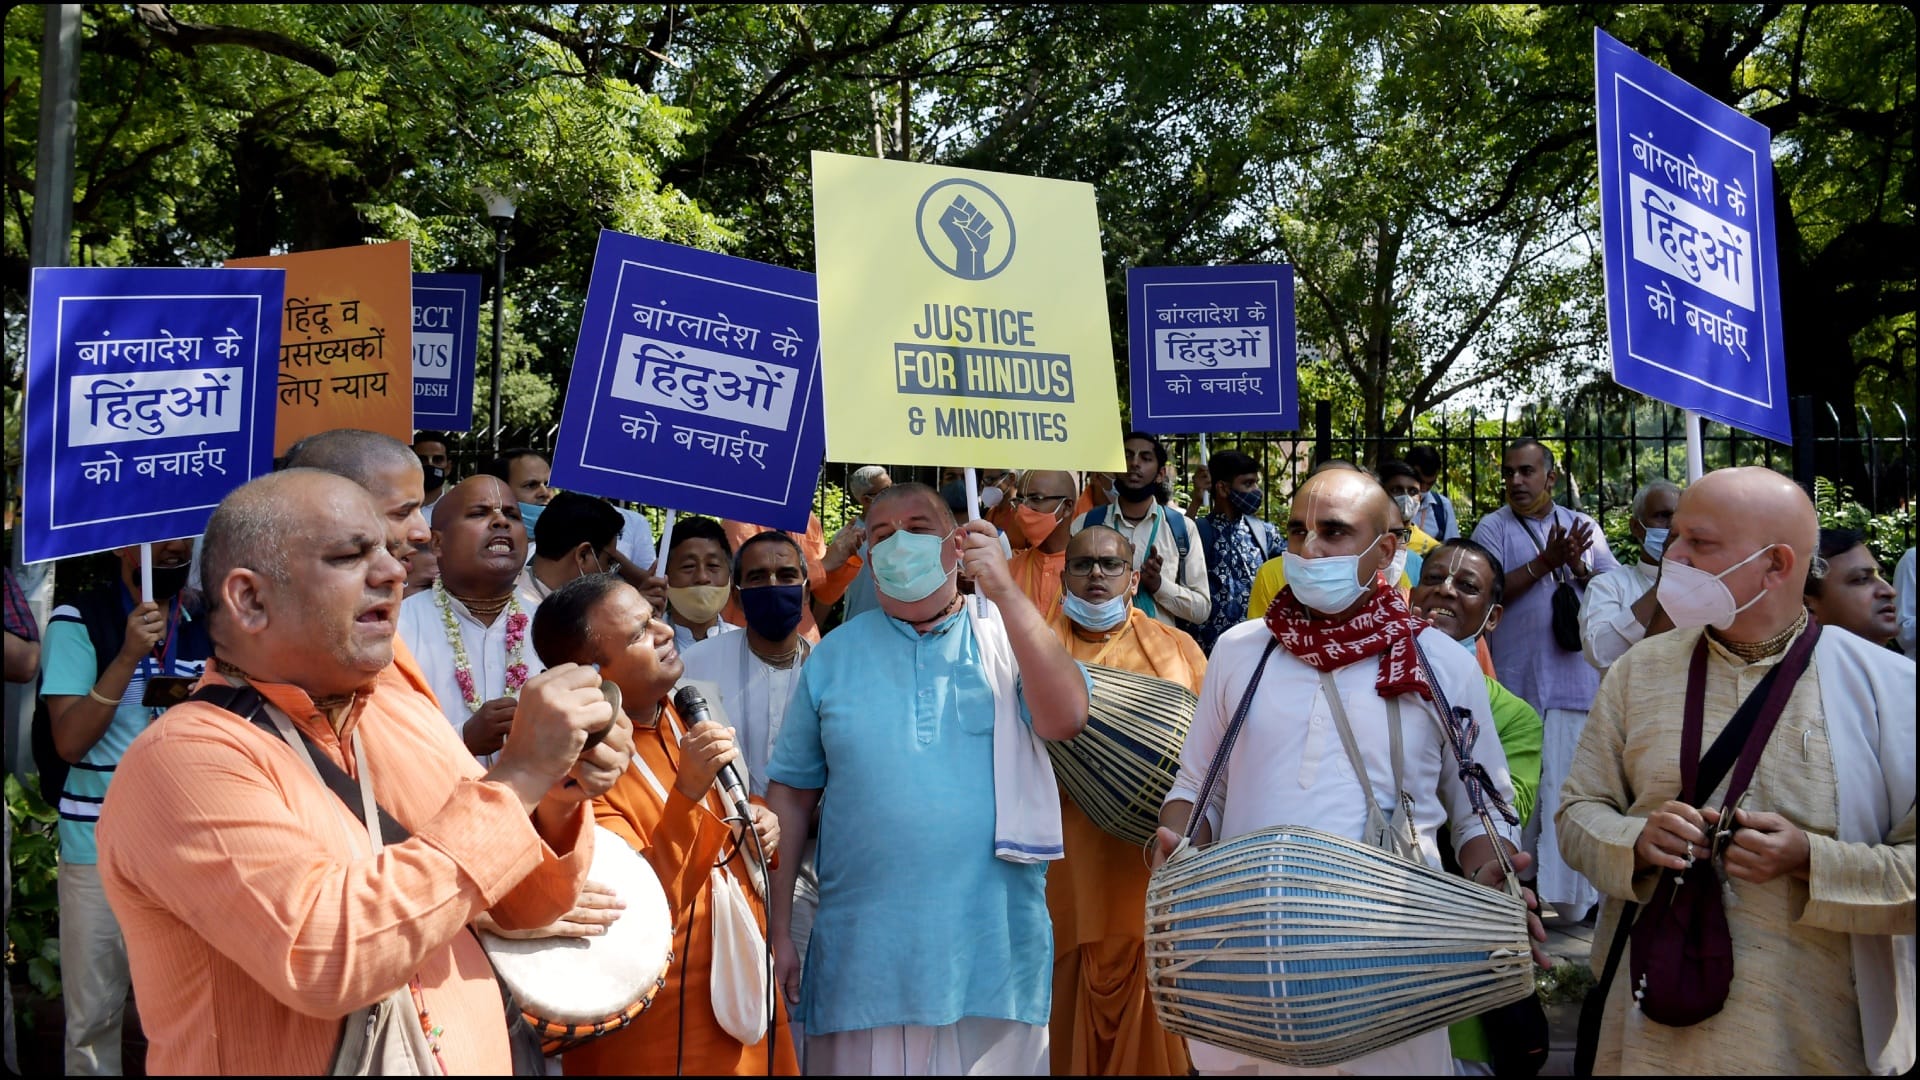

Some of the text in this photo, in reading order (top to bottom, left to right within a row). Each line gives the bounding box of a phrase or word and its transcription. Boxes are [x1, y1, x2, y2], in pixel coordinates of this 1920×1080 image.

[1630, 131, 1748, 217] बांग्लादेश के
[1641, 189, 1743, 284] हिंदुओं
[285, 298, 361, 334] हिंदू व
[632, 300, 804, 358] बांग्लादेश के
[914, 304, 1035, 347] JUSTICE
[1156, 301, 1267, 324] बांग्लादेश के
[1645, 280, 1750, 362] को बचाईए
[75, 328, 244, 366] बांग्लादेश के
[412, 343, 449, 368] US
[1164, 330, 1261, 366] हिंदुओं
[331, 373, 389, 399] न्याय
[632, 344, 786, 412] हिंदुओं
[898, 350, 1069, 397] FOR HINDUS
[1165, 372, 1263, 395] को बचाईए
[84, 373, 231, 434] हिंदुओं
[909, 407, 1068, 443] & MINORITIES
[620, 411, 768, 470] को बचाईए
[81, 441, 226, 485] को बचाईए
